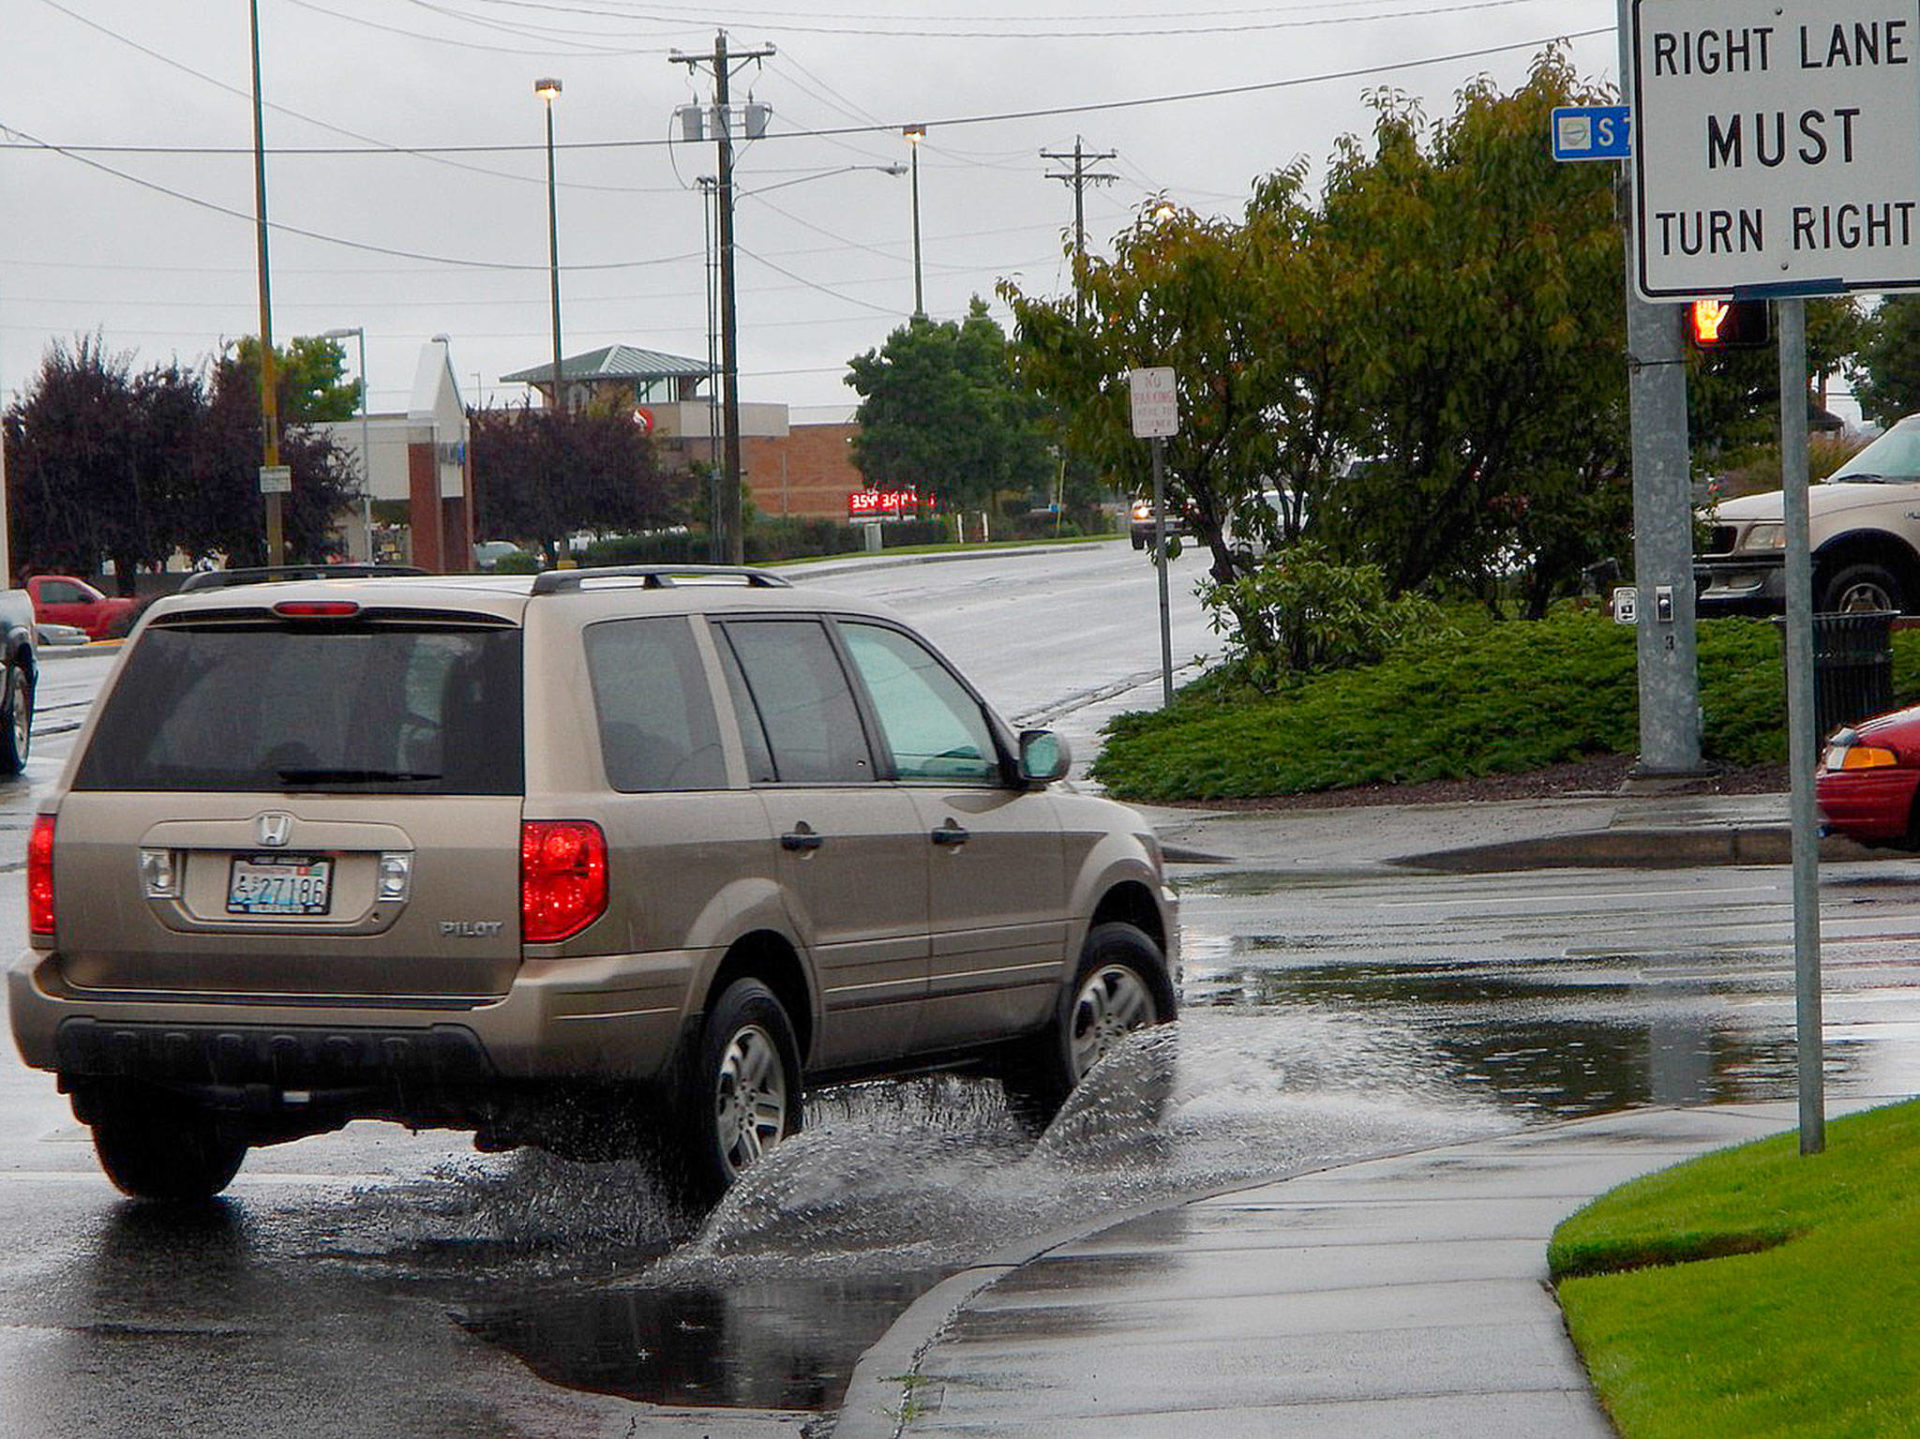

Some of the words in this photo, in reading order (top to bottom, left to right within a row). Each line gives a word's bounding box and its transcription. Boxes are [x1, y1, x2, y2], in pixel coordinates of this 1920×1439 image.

[1654, 27, 1774, 76] RIGHT
[1800, 20, 1909, 69] LANE
[1708, 108, 1860, 169] MUST
[1655, 208, 1763, 256] TURN
[1793, 202, 1916, 250] RIGHT
[1145, 375, 1162, 388] NO
[1665, 635, 1674, 650] 3
[440, 921, 504, 937] PILOT
